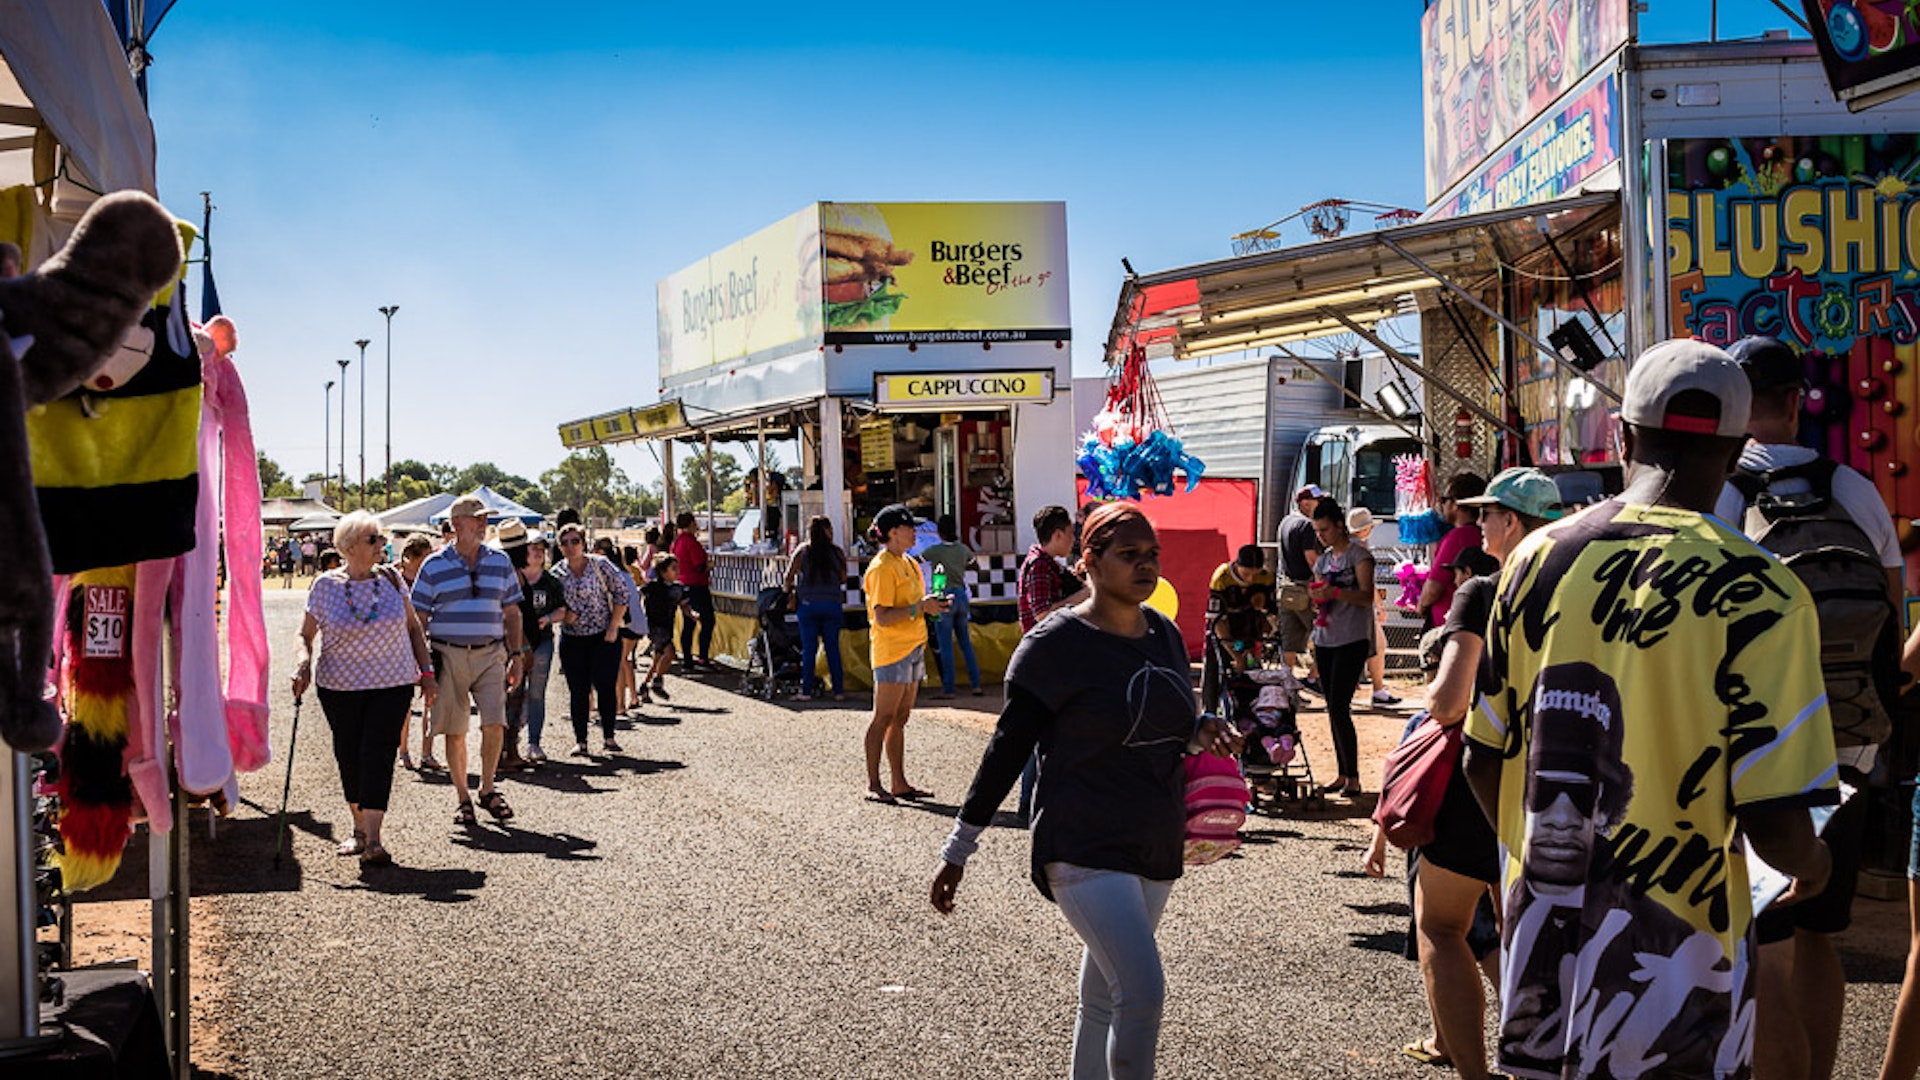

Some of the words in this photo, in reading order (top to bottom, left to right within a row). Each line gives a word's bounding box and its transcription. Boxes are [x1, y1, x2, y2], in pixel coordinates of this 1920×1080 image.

[931, 240, 1022, 266] Burgers
[1011, 273, 1032, 288] the
[1037, 271, 1052, 287] go
[874, 330, 1027, 343] www.burgersnbeef.com.au
[908, 377, 1026, 396] CAPPUCCINO
[88, 587, 126, 613] SALE
[88, 616, 122, 640] $10
